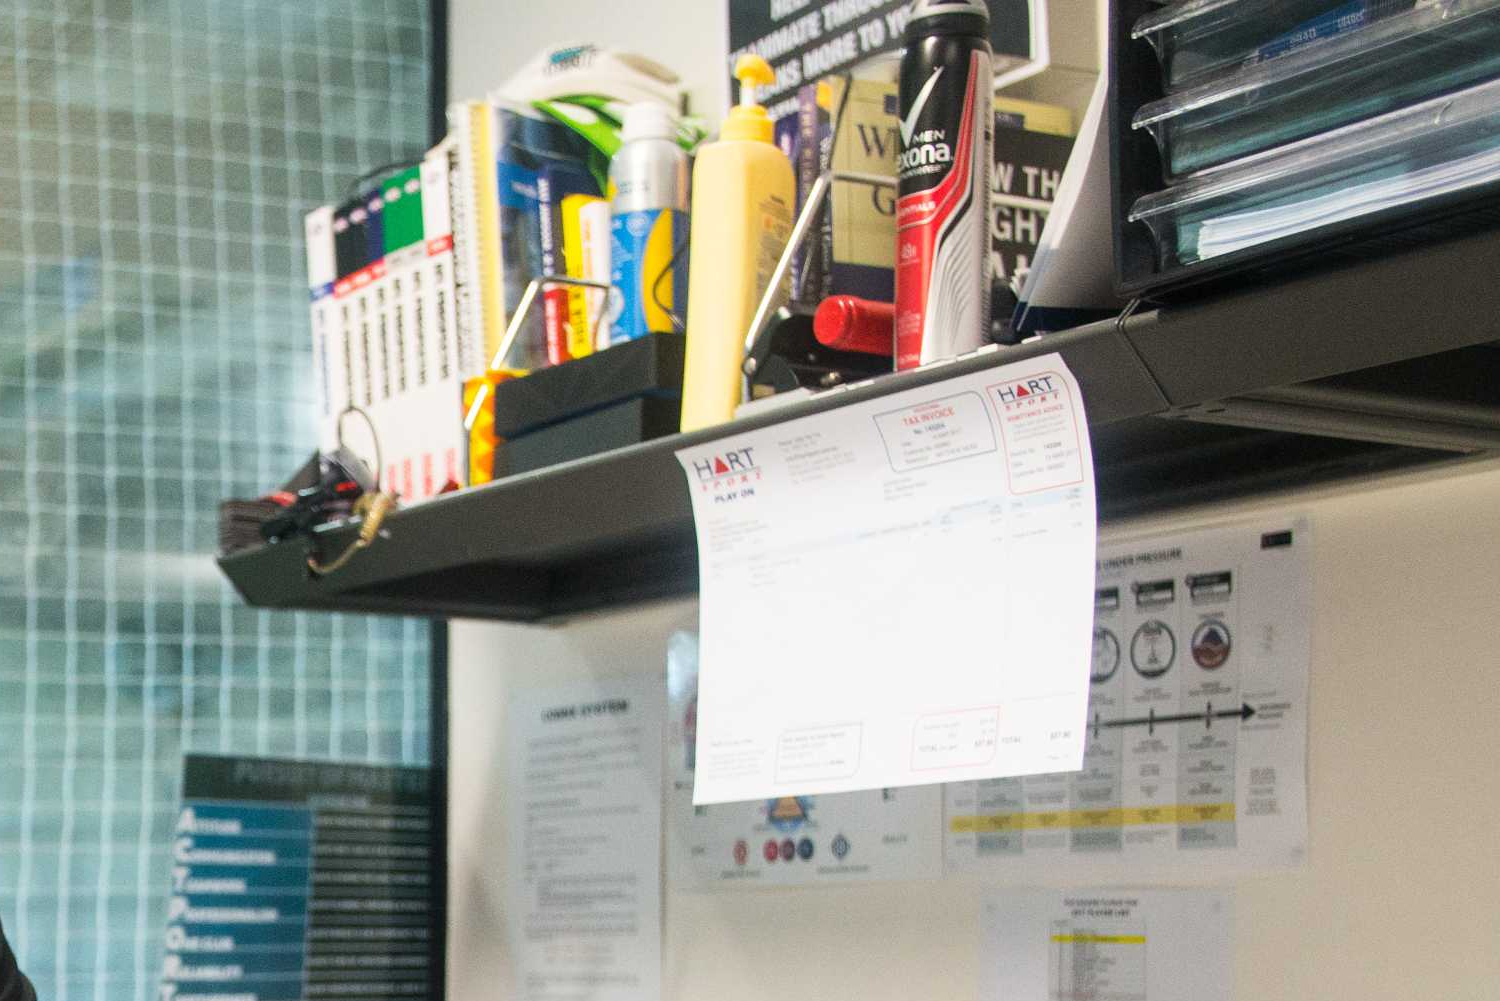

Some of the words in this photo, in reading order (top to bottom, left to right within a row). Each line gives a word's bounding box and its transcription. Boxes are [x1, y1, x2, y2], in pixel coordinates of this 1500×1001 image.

[857, 18, 886, 51] TO
[912, 130, 946, 144] MEN
[998, 376, 1053, 401] HART
[693, 447, 755, 480] HART
